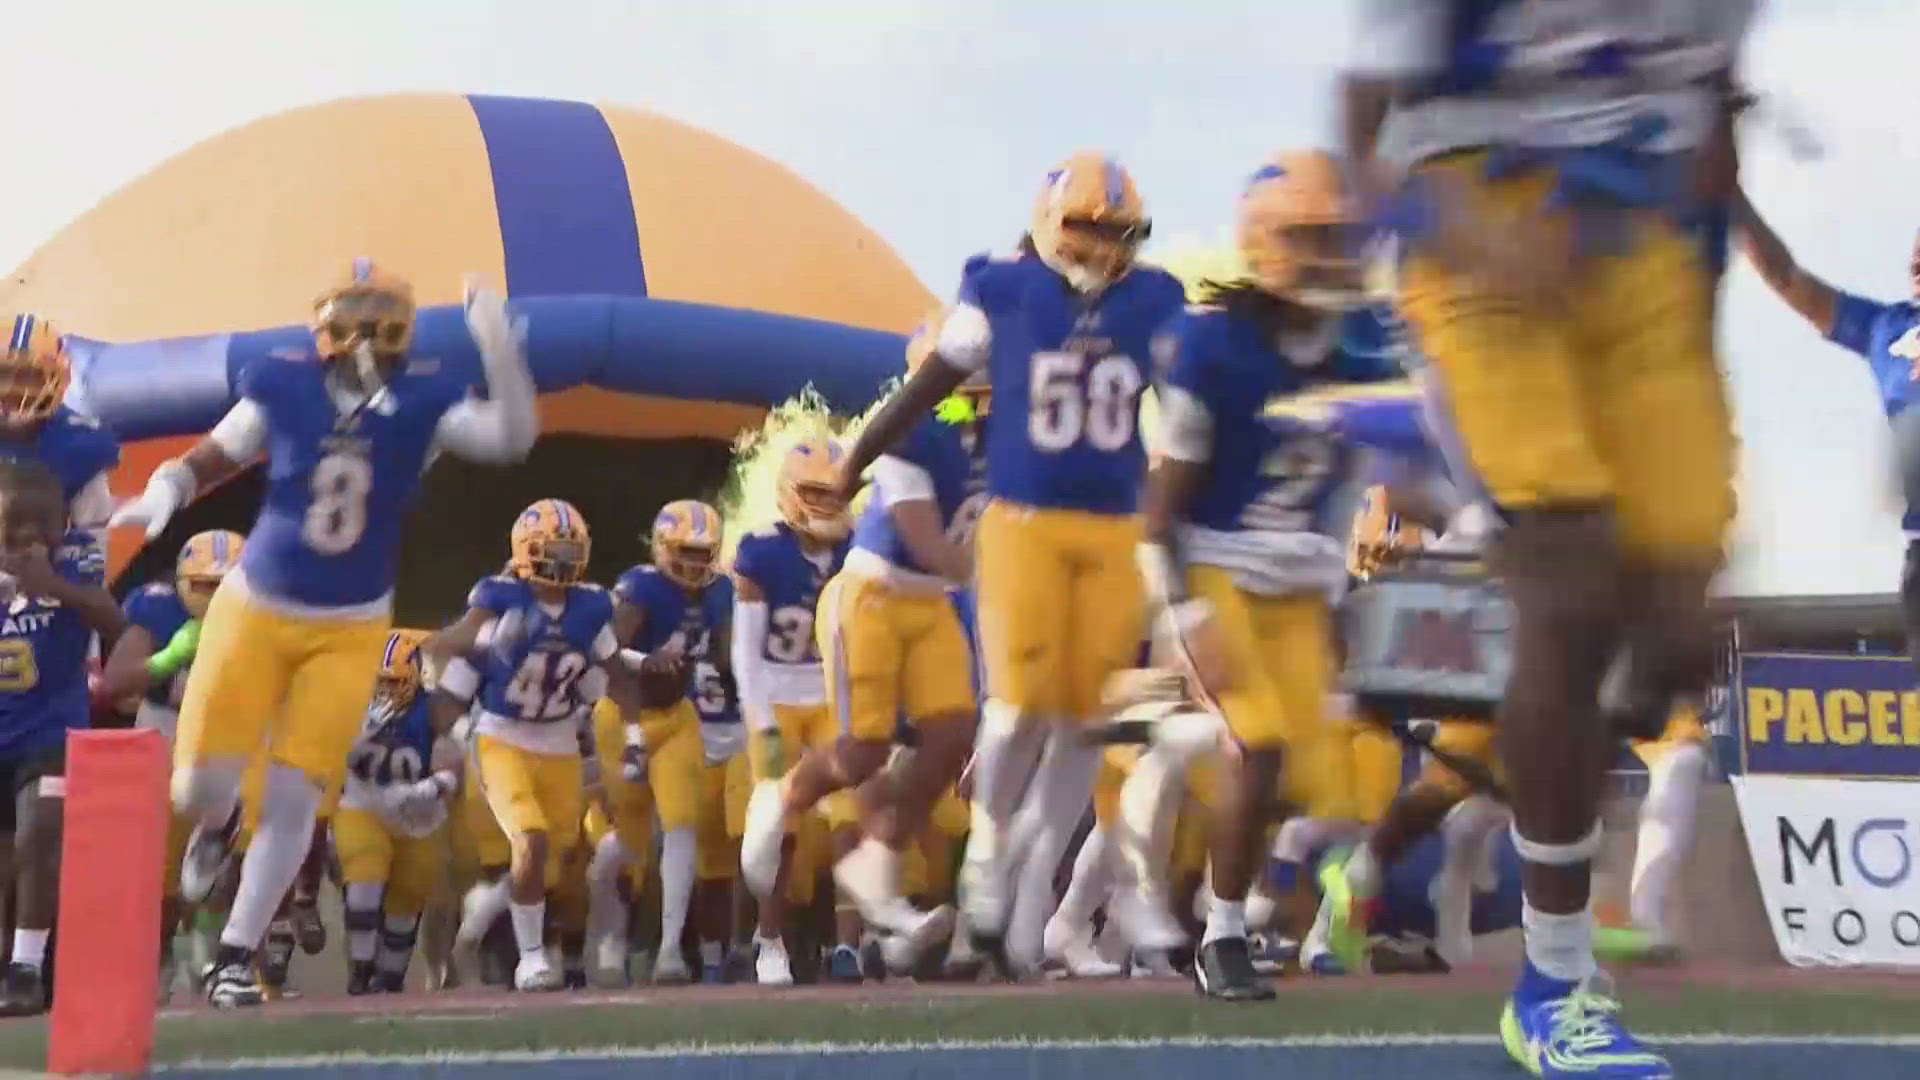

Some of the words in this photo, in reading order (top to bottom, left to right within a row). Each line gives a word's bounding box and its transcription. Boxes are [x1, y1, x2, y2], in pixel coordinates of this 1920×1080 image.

[303, 453, 373, 554] 8
[768, 606, 815, 662] 3
[505, 651, 587, 719] 42
